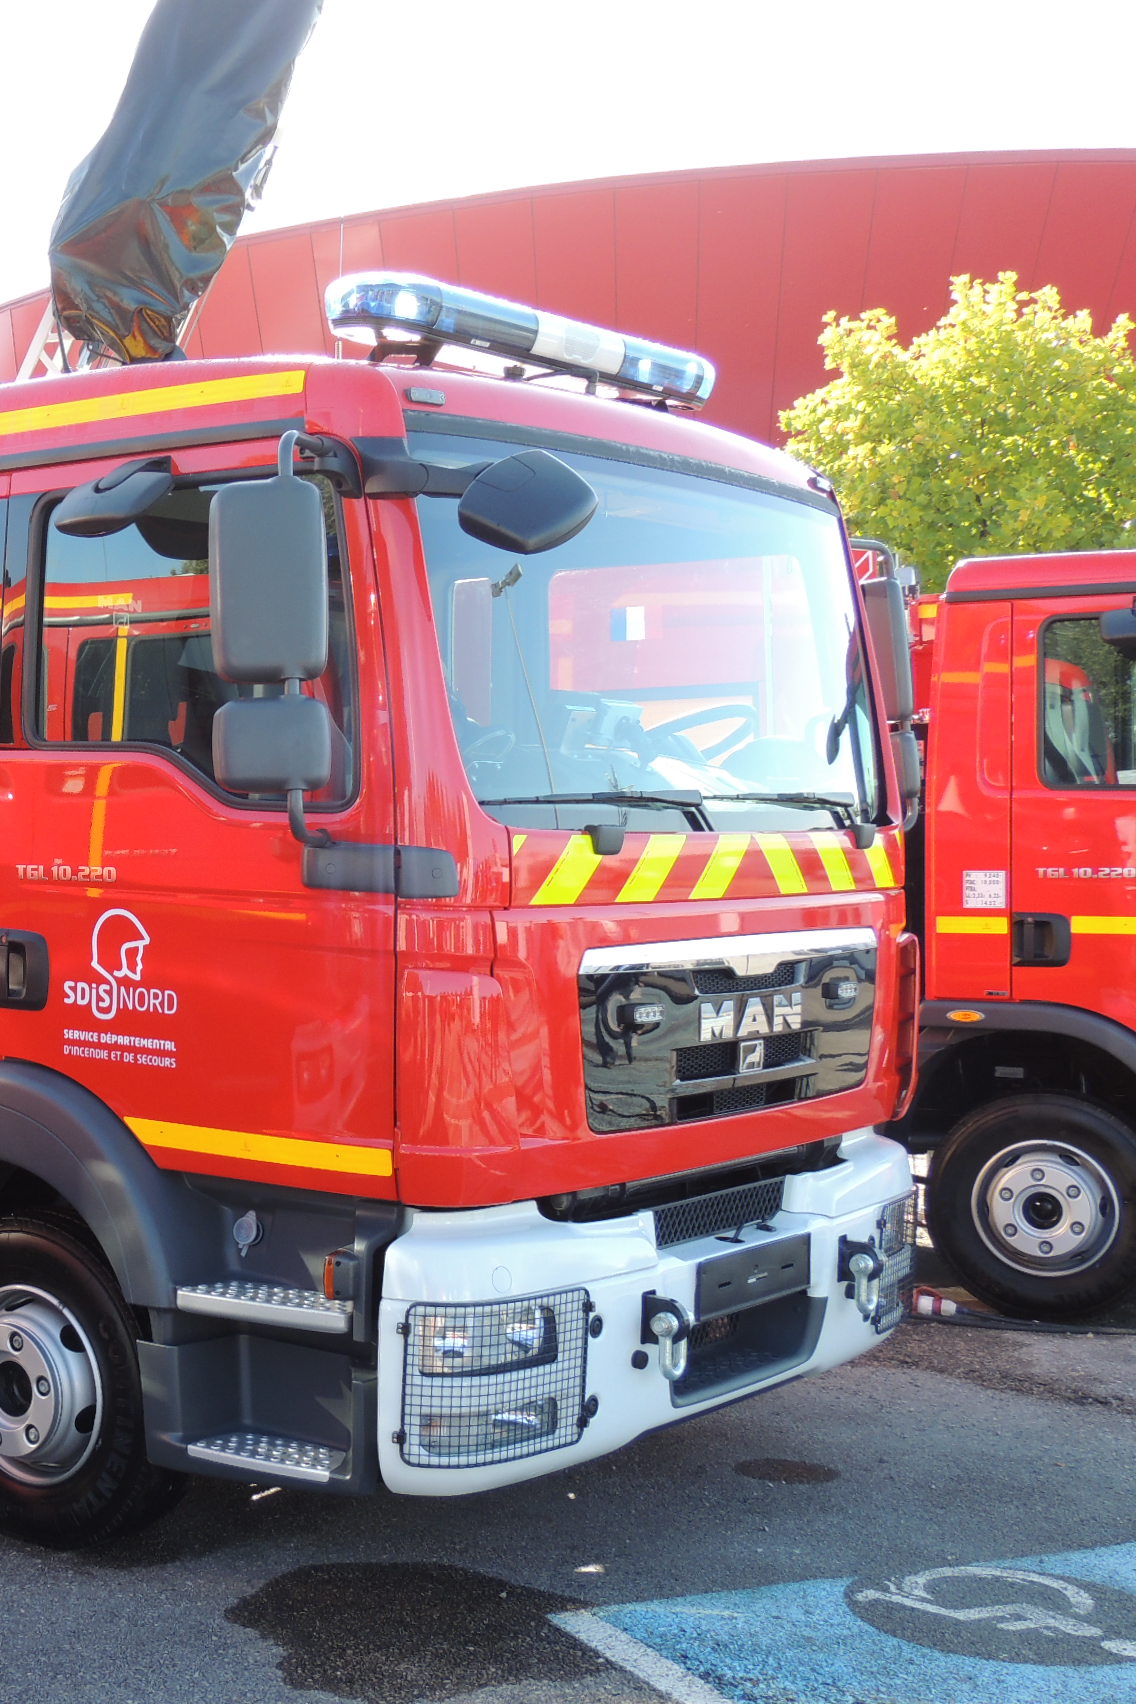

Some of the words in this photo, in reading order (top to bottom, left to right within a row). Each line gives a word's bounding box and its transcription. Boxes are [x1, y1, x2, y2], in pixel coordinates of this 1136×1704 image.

[98, 595, 142, 612] MAN
[16, 864, 48, 881] TGL
[51, 865, 117, 882] 10.220
[1035, 867, 1070, 879] TGL
[1072, 867, 1136, 879] 10.220
[120, 986, 177, 1014] NORD
[700, 992, 802, 1042] MAN
[63, 1029, 98, 1043] SERVICE
[100, 1032, 177, 1052] DÉPARTEMENTAL
[63, 1045, 109, 1060] D'INCENDIE
[111, 1050, 121, 1061] ET
[123, 1052, 135, 1064] DE
[137, 1054, 177, 1069] SECOURS
